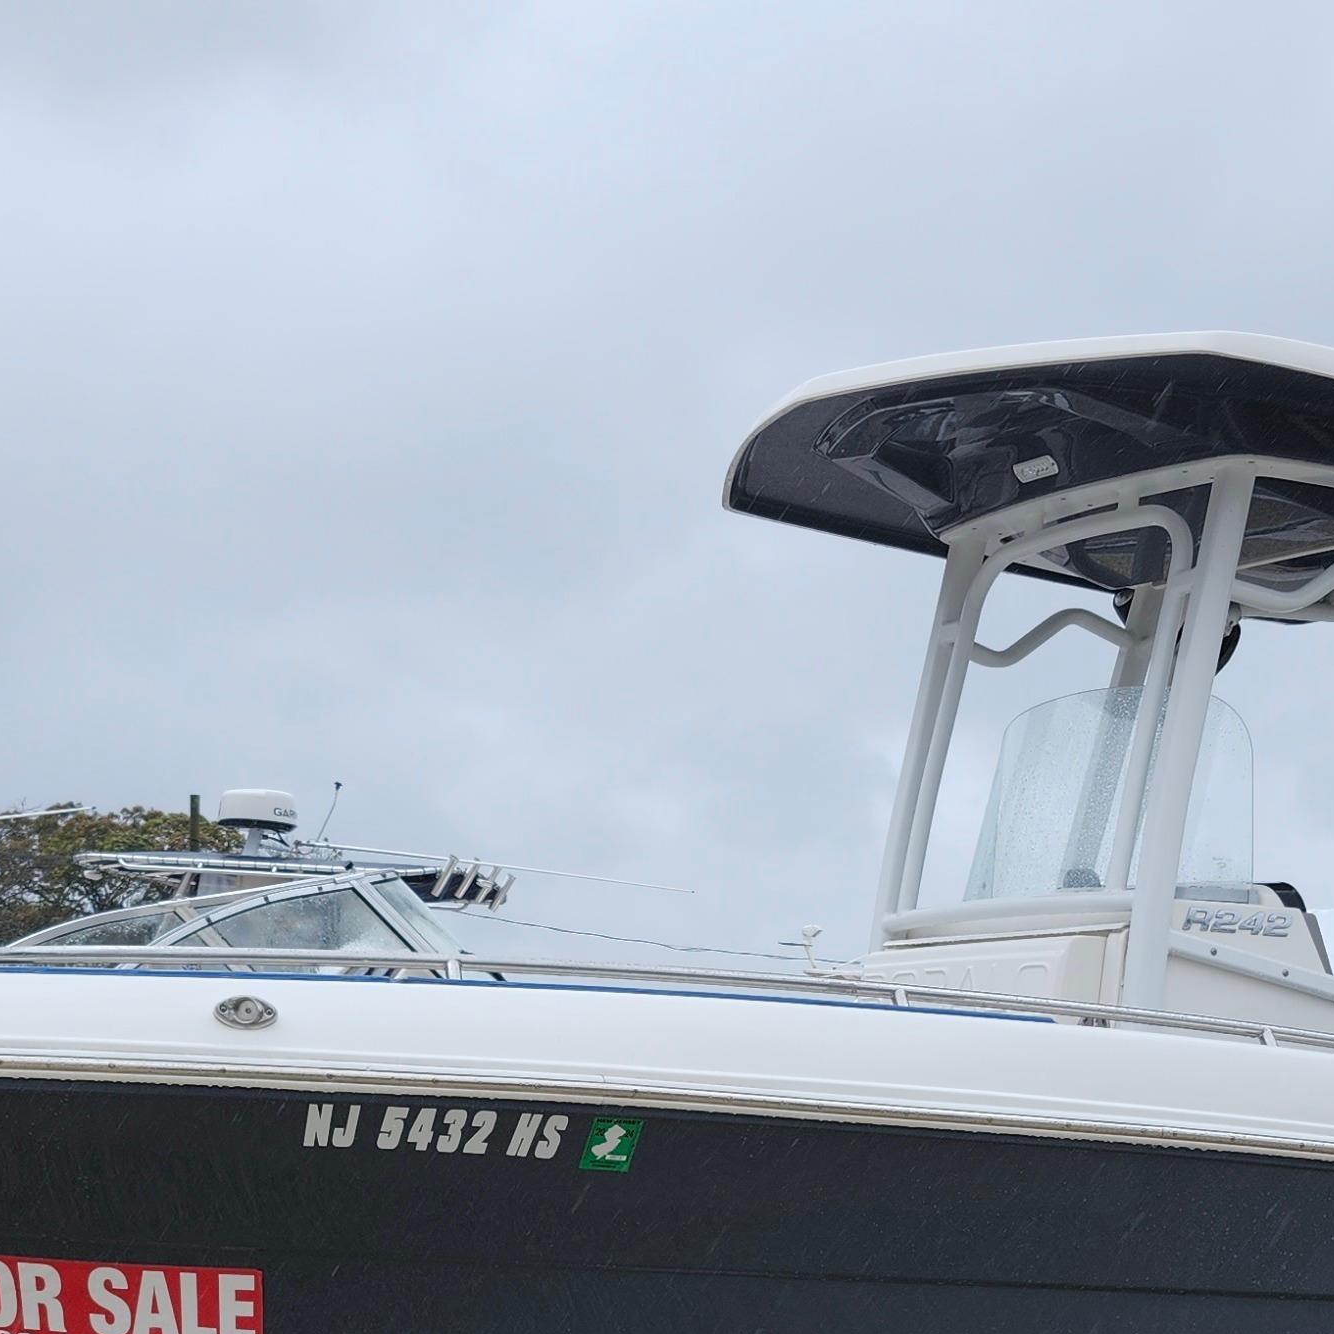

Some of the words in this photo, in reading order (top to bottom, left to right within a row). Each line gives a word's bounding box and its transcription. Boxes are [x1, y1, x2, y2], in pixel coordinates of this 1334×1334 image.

[1181, 906, 1293, 938] R242
[303, 1103, 362, 1148] NJ
[376, 1106, 498, 1154] 5432
[505, 1112, 569, 1159] HS
